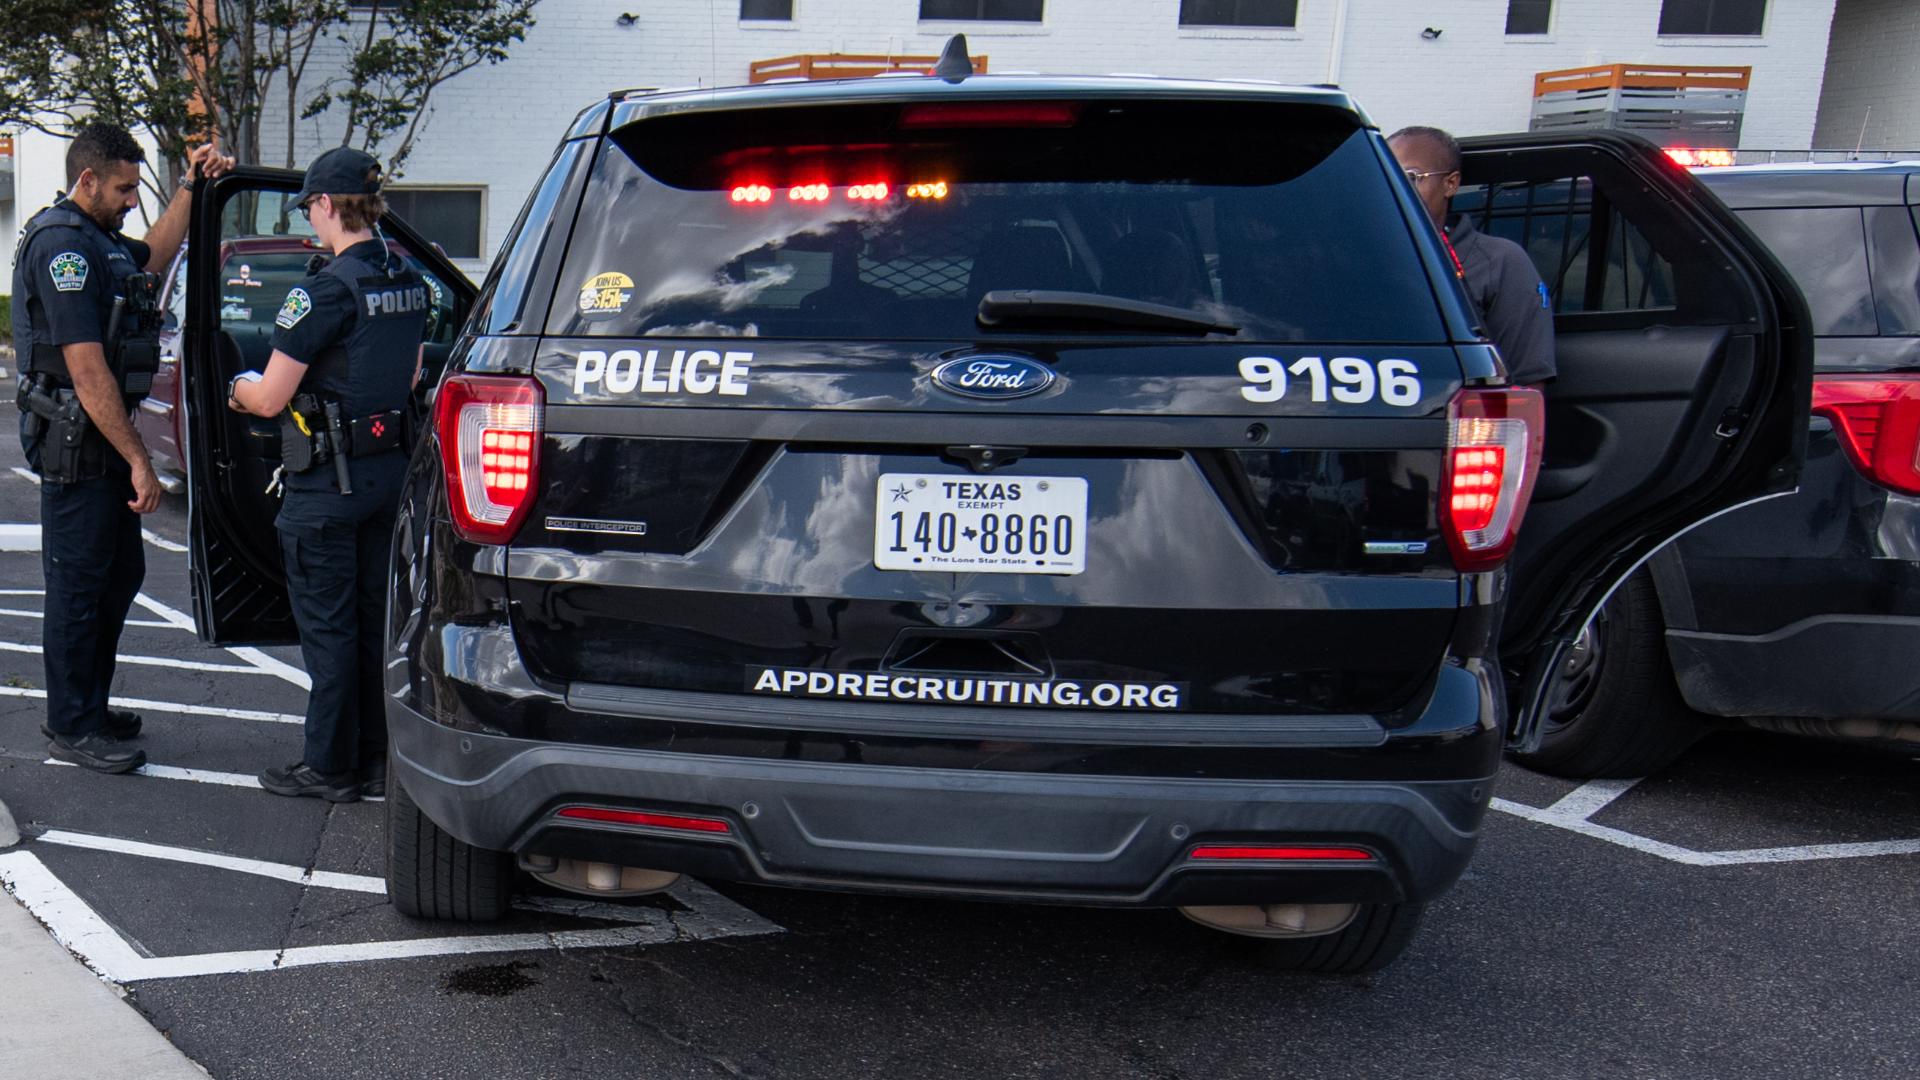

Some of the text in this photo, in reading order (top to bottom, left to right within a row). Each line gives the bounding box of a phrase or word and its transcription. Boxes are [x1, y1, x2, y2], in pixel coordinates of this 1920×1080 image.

[52, 254, 86, 269] POLICE
[595, 275, 623, 287] JOIN US
[573, 349, 754, 396] POLICE
[959, 361, 1028, 388] Ford
[1238, 356, 1421, 407] 9196
[942, 482, 1021, 501] TEXAS
[957, 501, 1004, 510] EXEMPT
[547, 520, 643, 532] POLICE INTERCEPTOR
[889, 511, 1073, 556] 140 8860
[1001, 557, 1027, 565] State
[753, 668, 1180, 709] APDRECRUITING.ORG
